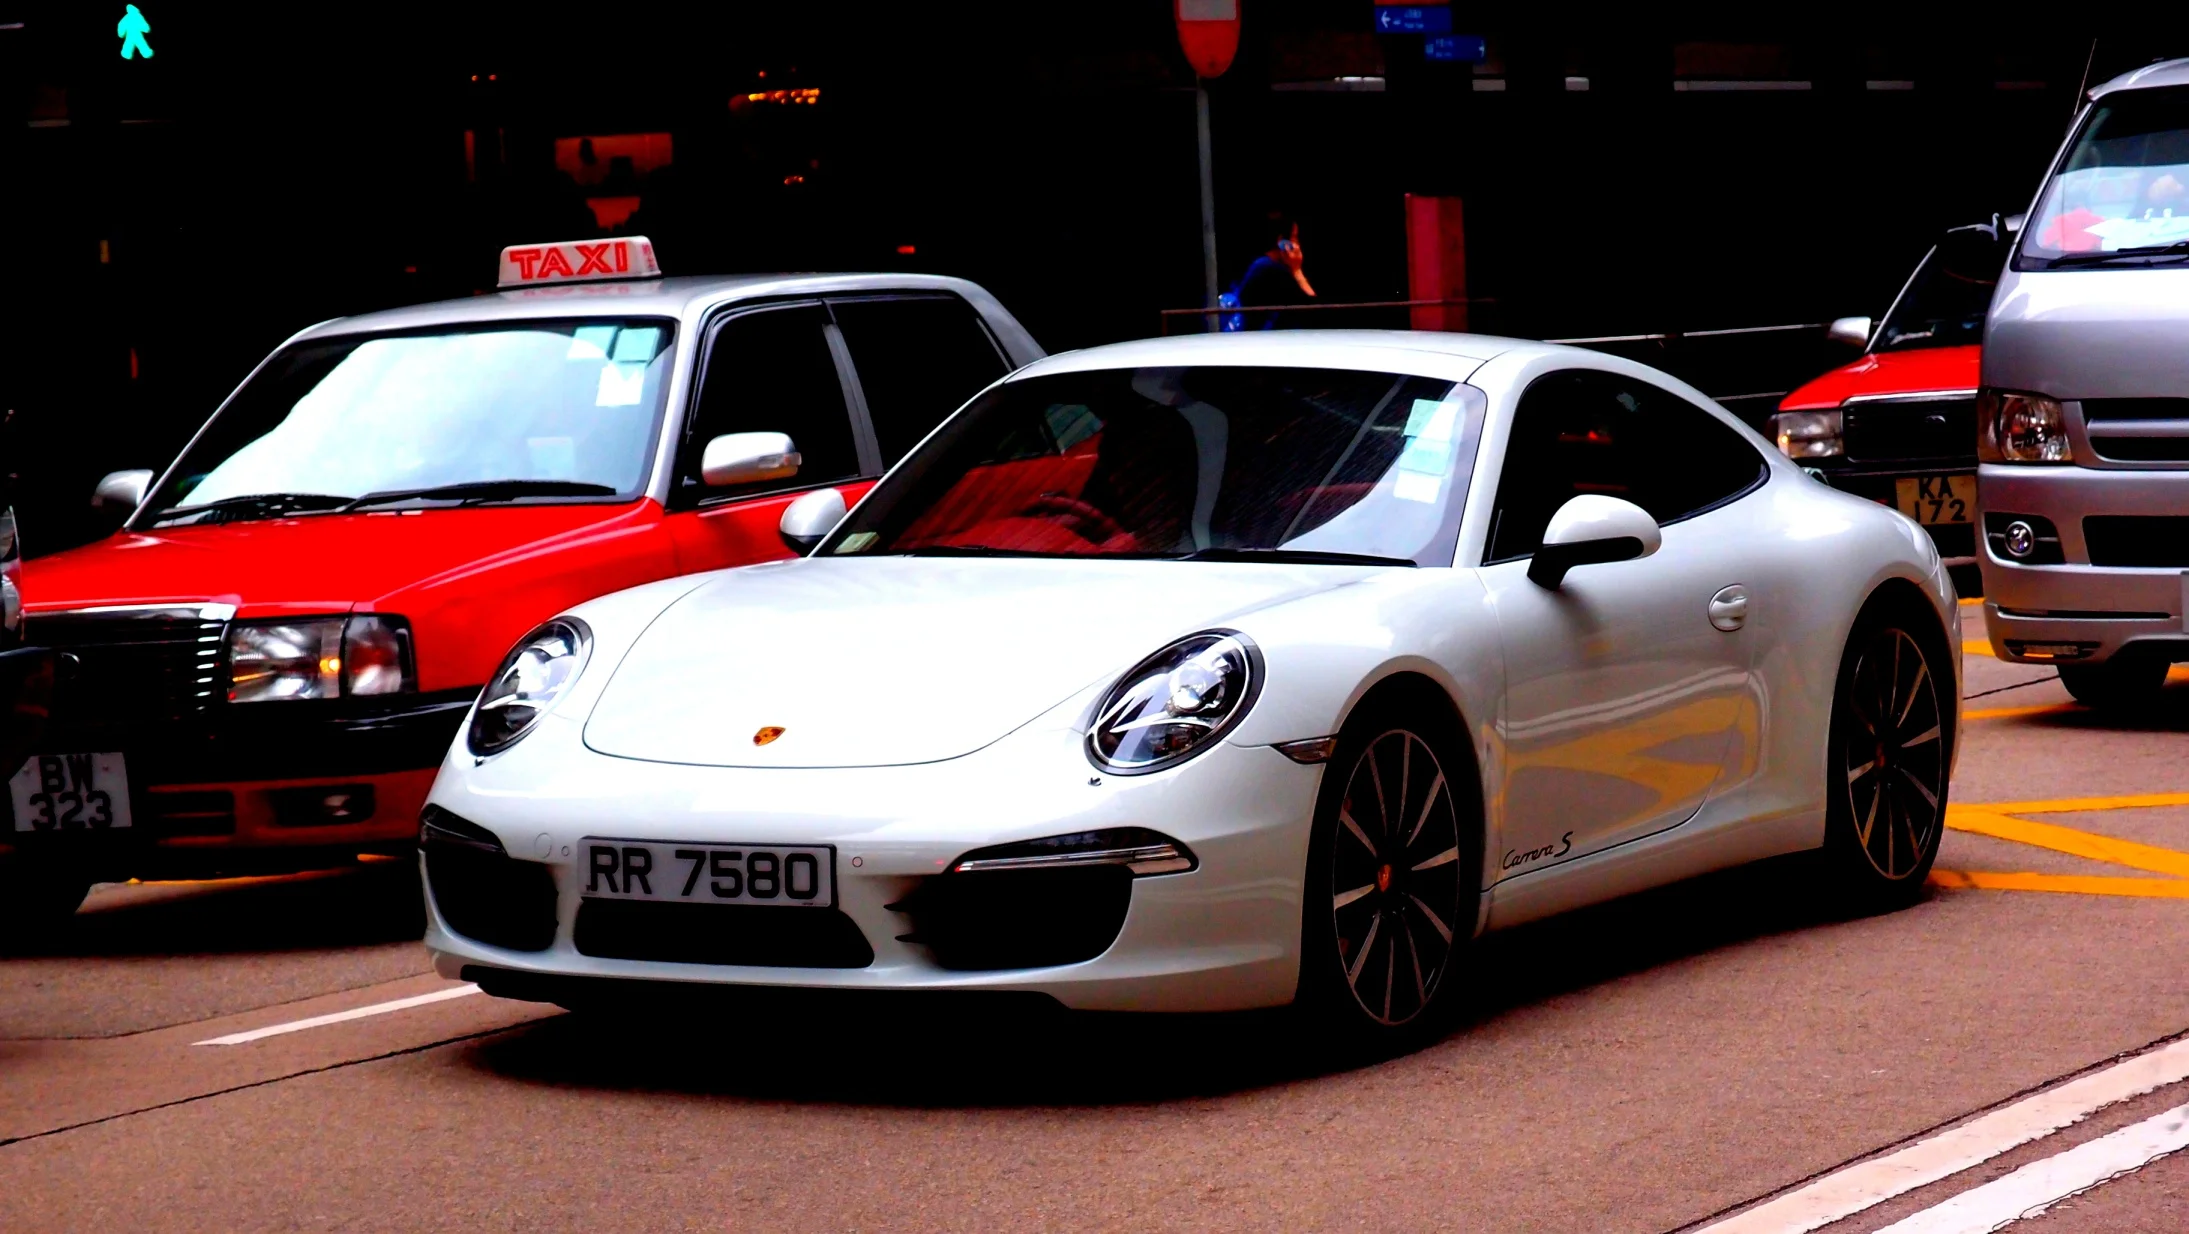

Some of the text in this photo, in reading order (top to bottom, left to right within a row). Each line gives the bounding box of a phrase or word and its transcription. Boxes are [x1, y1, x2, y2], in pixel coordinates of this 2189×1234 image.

[509, 241, 628, 280] TAXI
[1918, 476, 1954, 499] KA
[1915, 499, 1966, 523] 172
[38, 754, 93, 794] BW
[29, 790, 113, 830] 323
[1503, 830, 1574, 870] Carrera S
[590, 846, 818, 900] RR 7580
